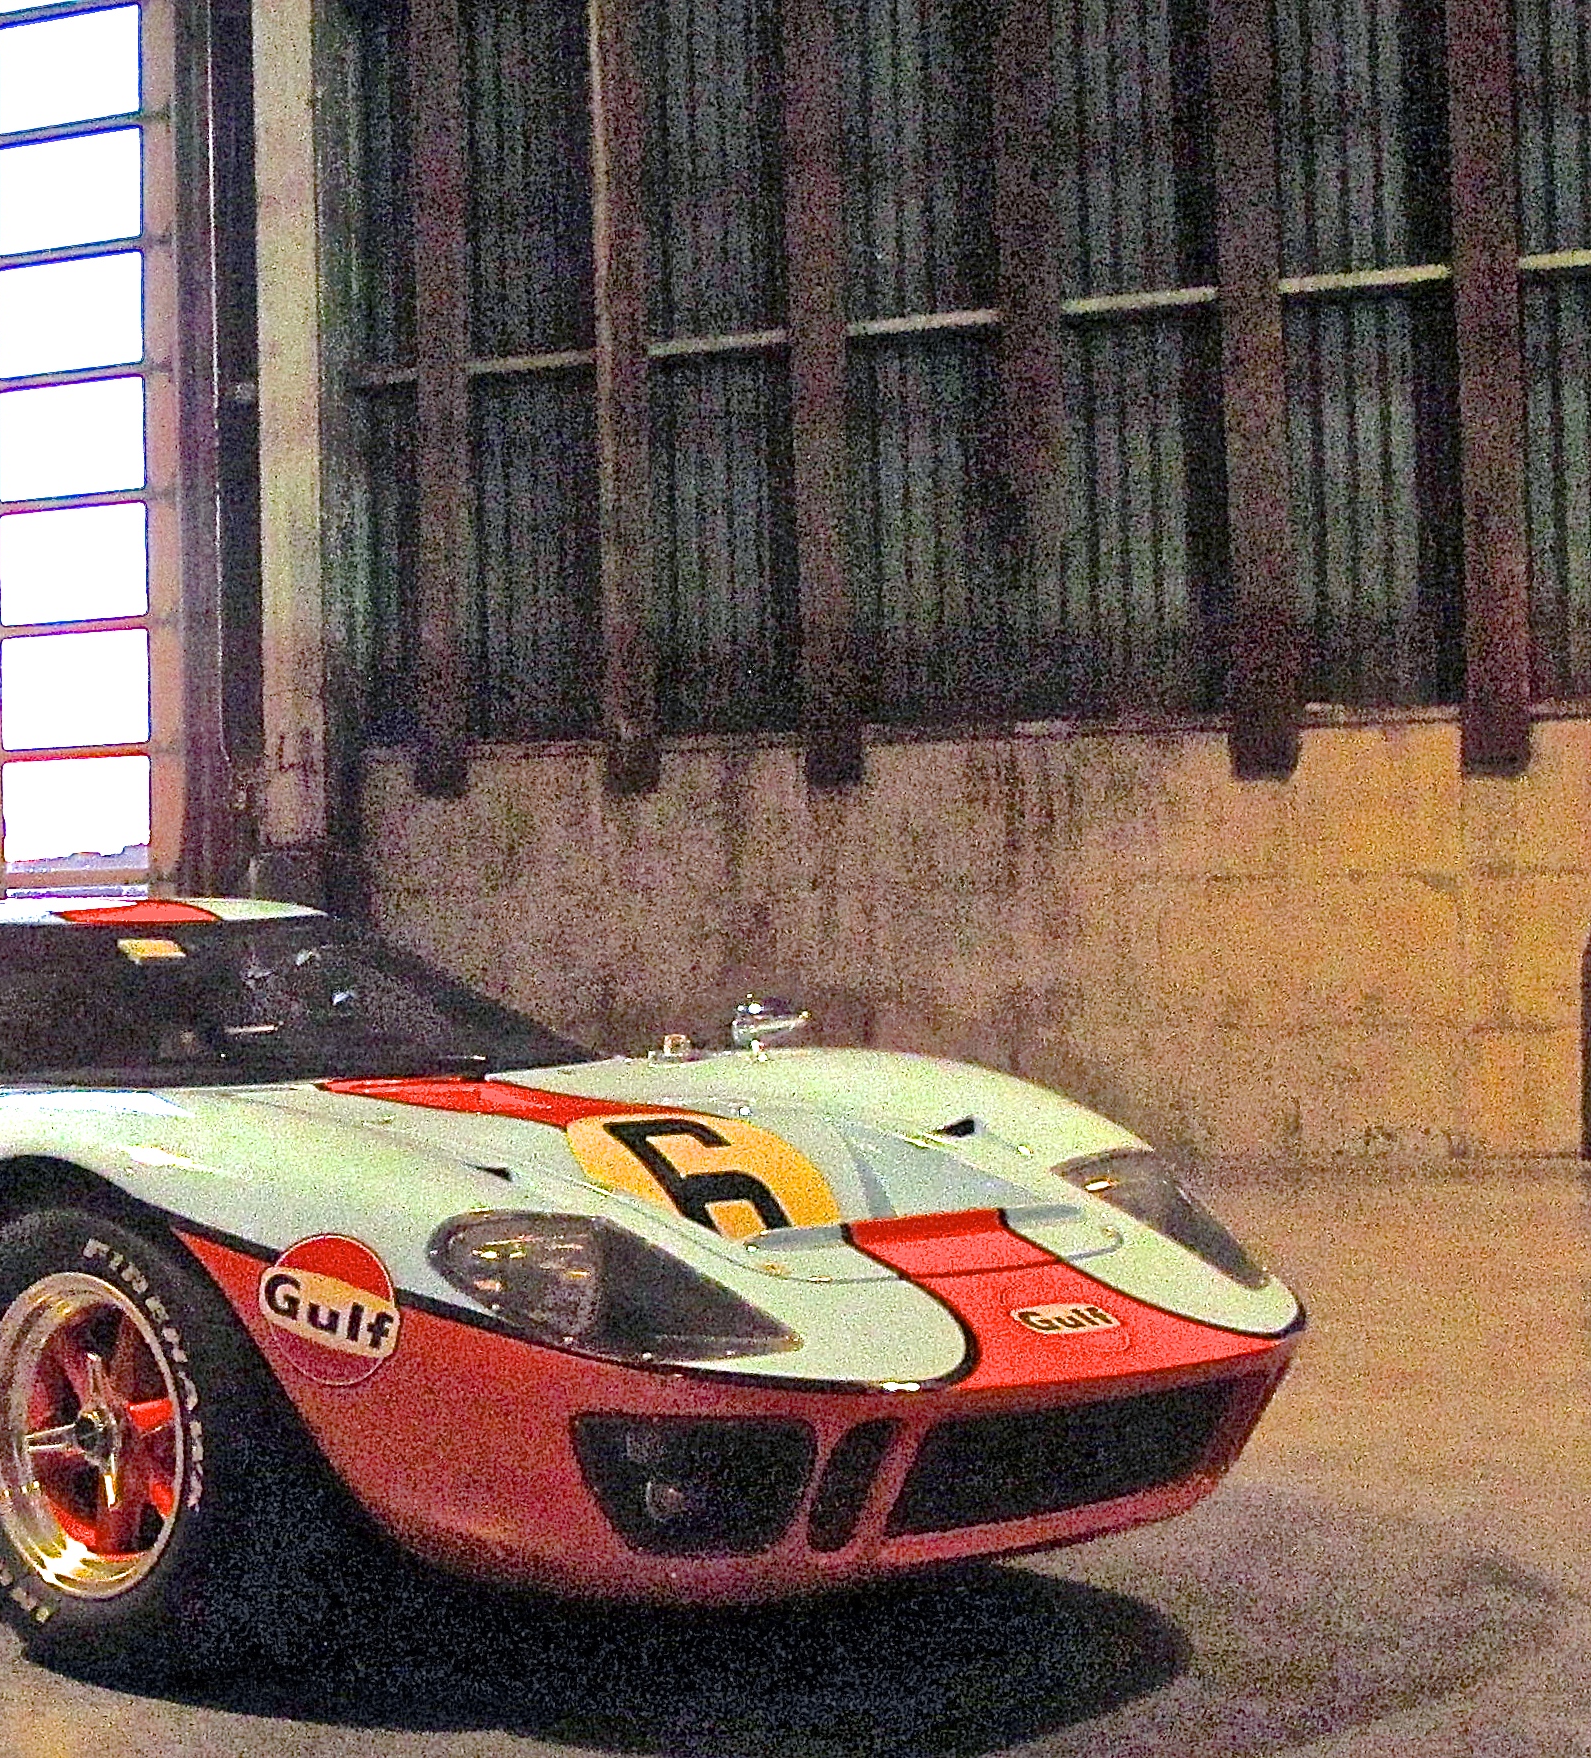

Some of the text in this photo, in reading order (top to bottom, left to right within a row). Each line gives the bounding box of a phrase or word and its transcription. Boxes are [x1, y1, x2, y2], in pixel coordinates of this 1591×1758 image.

[603, 1117, 794, 1238] 6
[264, 1273, 394, 1350] Gulf
[1017, 1306, 1114, 1331] Gulf
